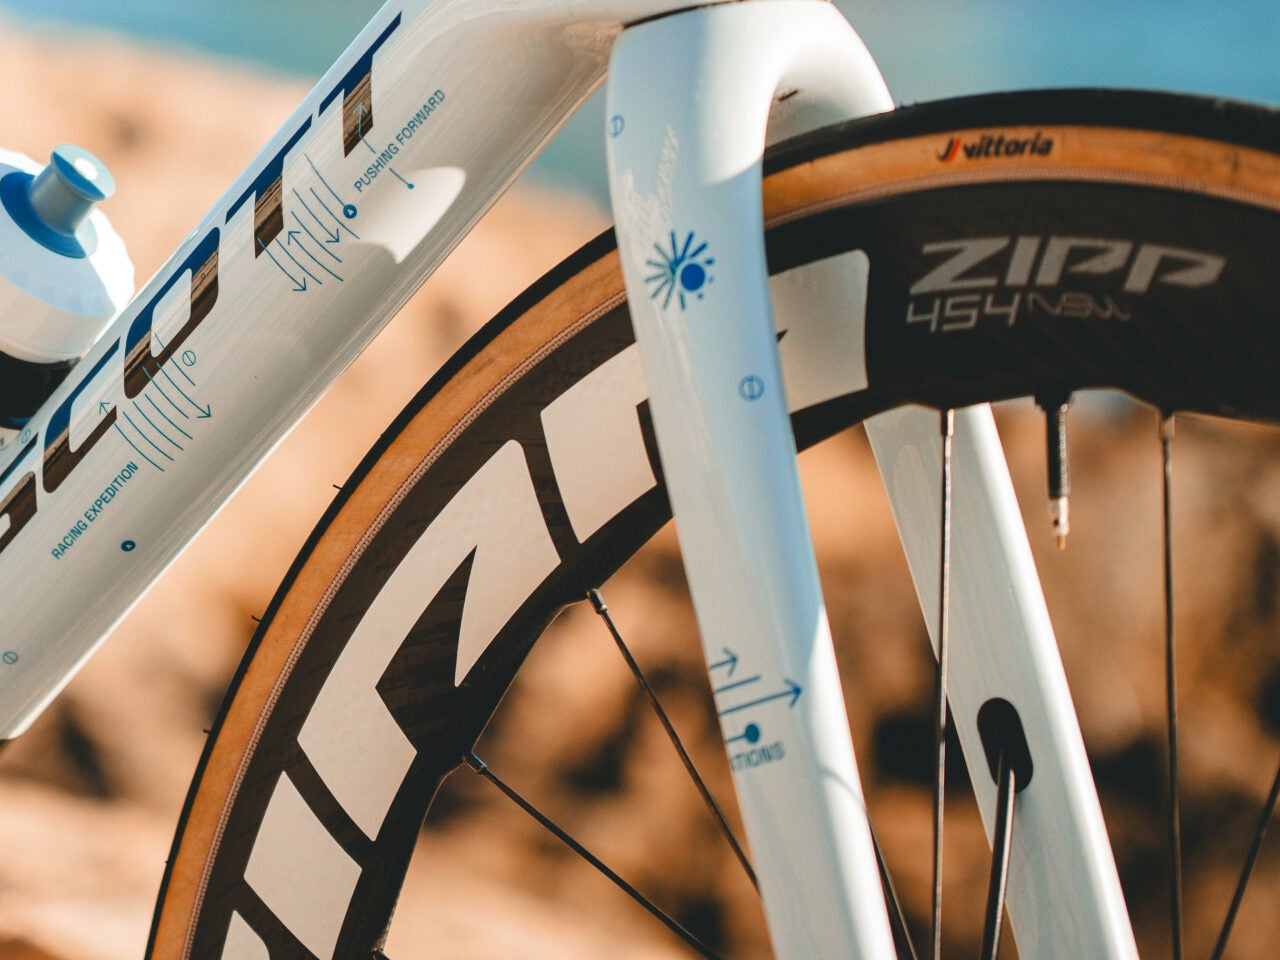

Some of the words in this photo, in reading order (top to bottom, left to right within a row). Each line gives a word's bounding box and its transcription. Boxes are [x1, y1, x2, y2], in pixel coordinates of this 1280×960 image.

[353, 143, 400, 193] PUSHING
[395, 89, 446, 146] FORWARD
[963, 131, 1055, 159] vittoria
[910, 236, 1227, 296] ZIPP
[906, 293, 1020, 334] 454
[51, 519, 88, 560] RACING
[84, 461, 139, 522] EXPEDITION
